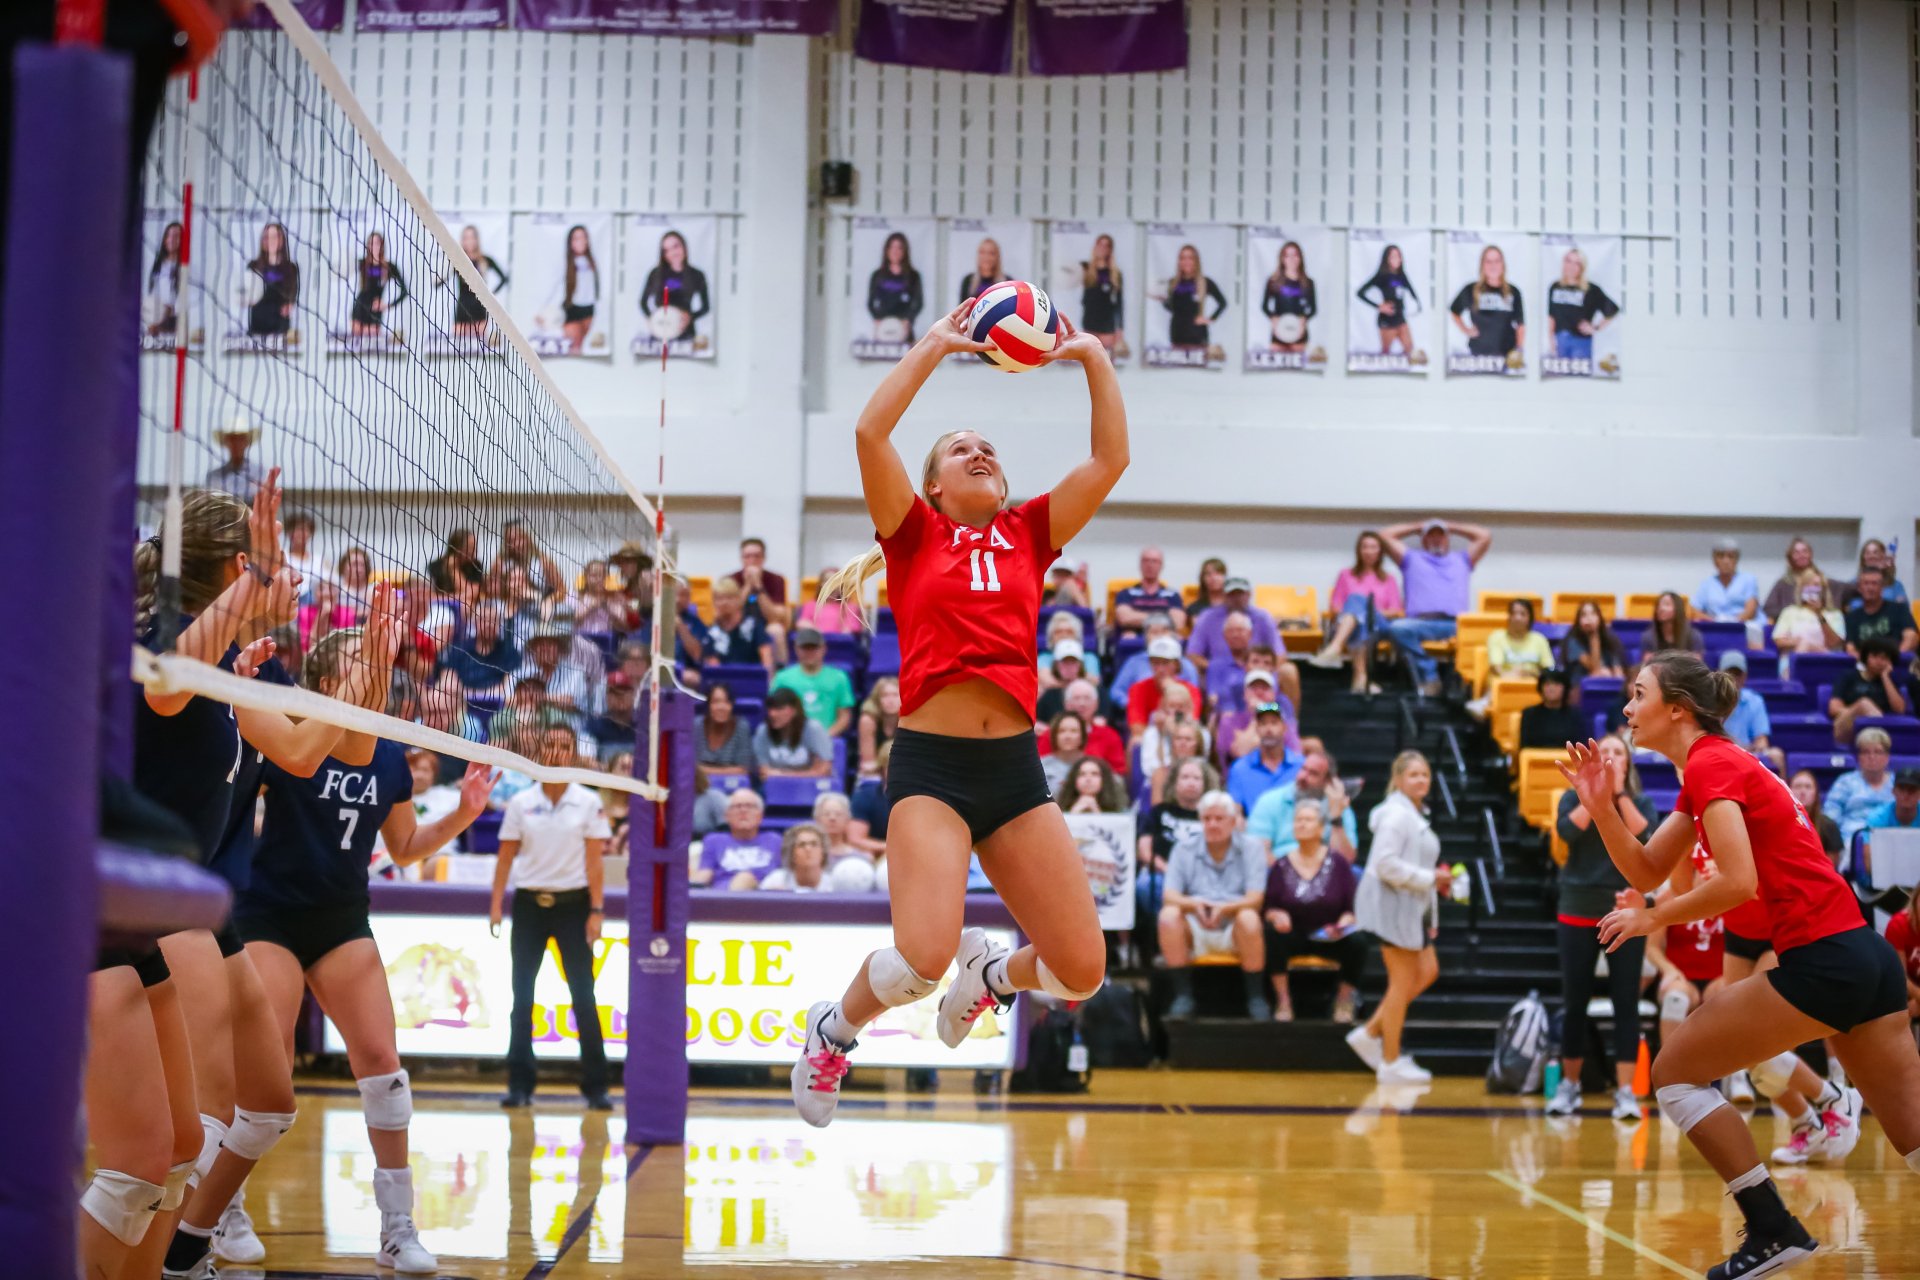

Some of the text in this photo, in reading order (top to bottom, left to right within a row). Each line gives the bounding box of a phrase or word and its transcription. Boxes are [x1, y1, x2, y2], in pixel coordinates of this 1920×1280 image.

[971, 299, 990, 319] FCA
[970, 549, 1001, 592] 11
[318, 769, 378, 806] FCA
[339, 808, 359, 850] 7
